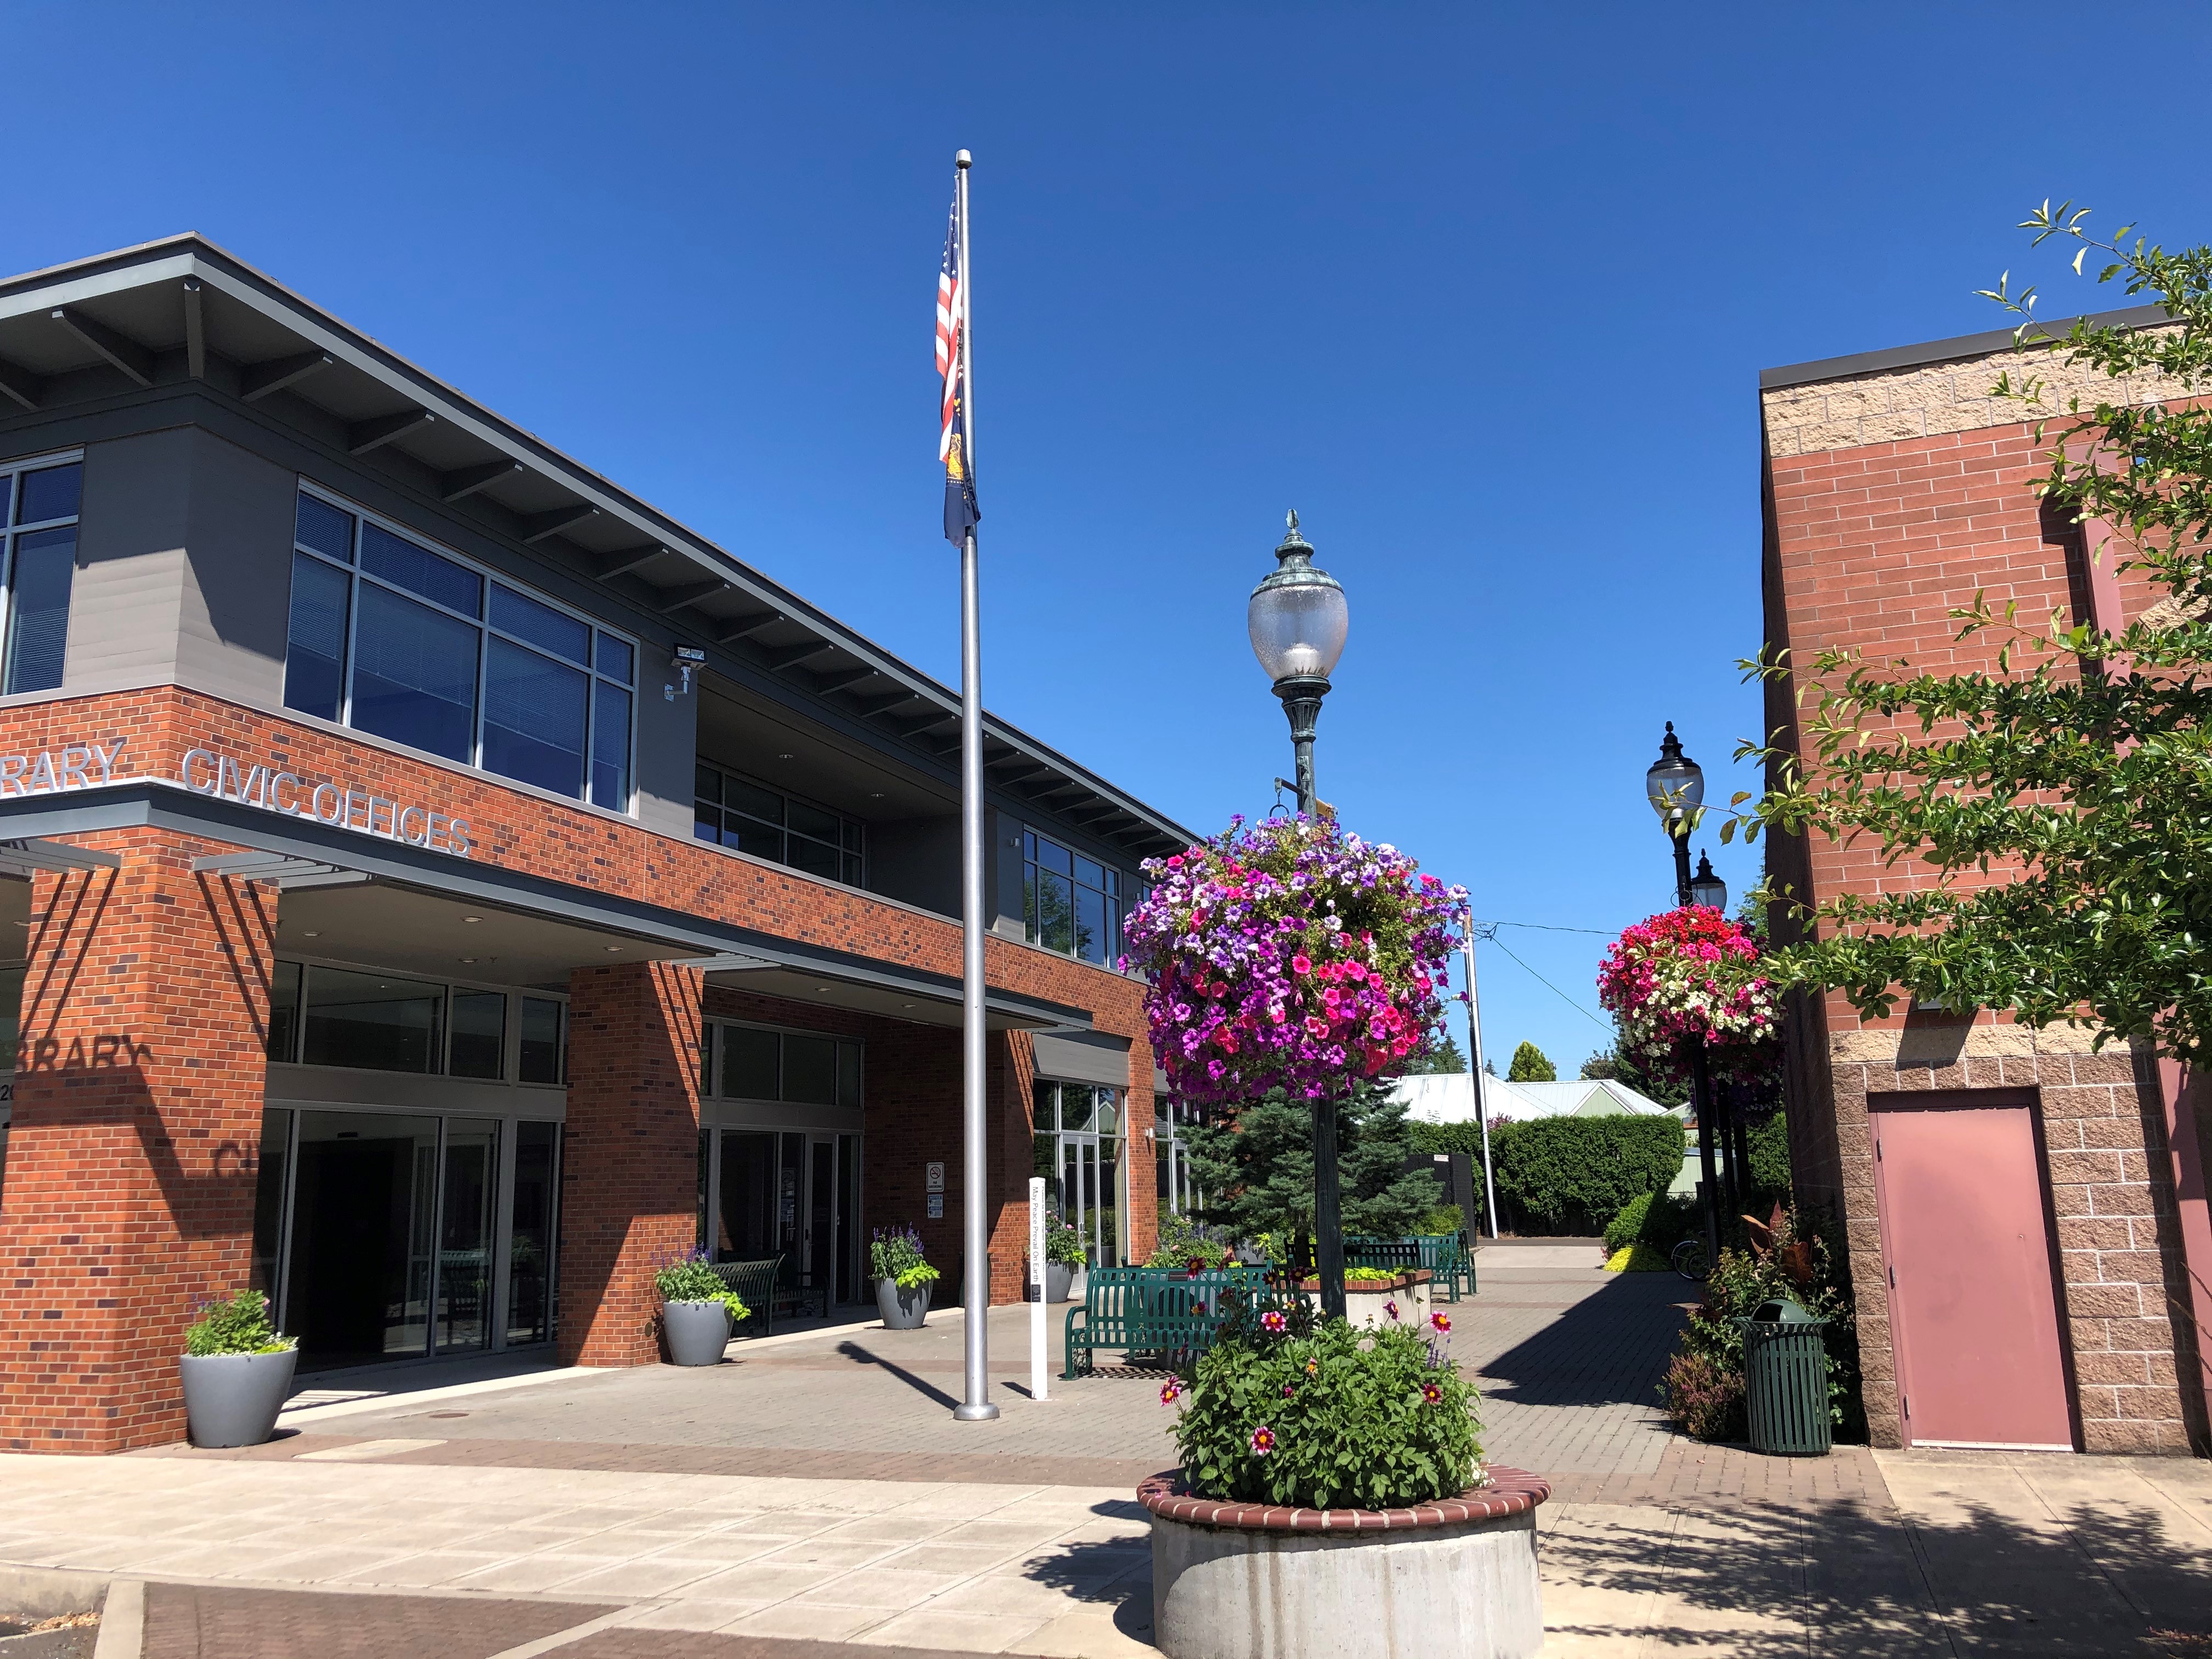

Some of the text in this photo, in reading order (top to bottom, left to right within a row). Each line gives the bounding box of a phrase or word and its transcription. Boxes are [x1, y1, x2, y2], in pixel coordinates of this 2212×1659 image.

[0, 741, 123, 796] RARY
[182, 749, 471, 857] CIVIC OFFICES
[1033, 1251, 1039, 1261] On
